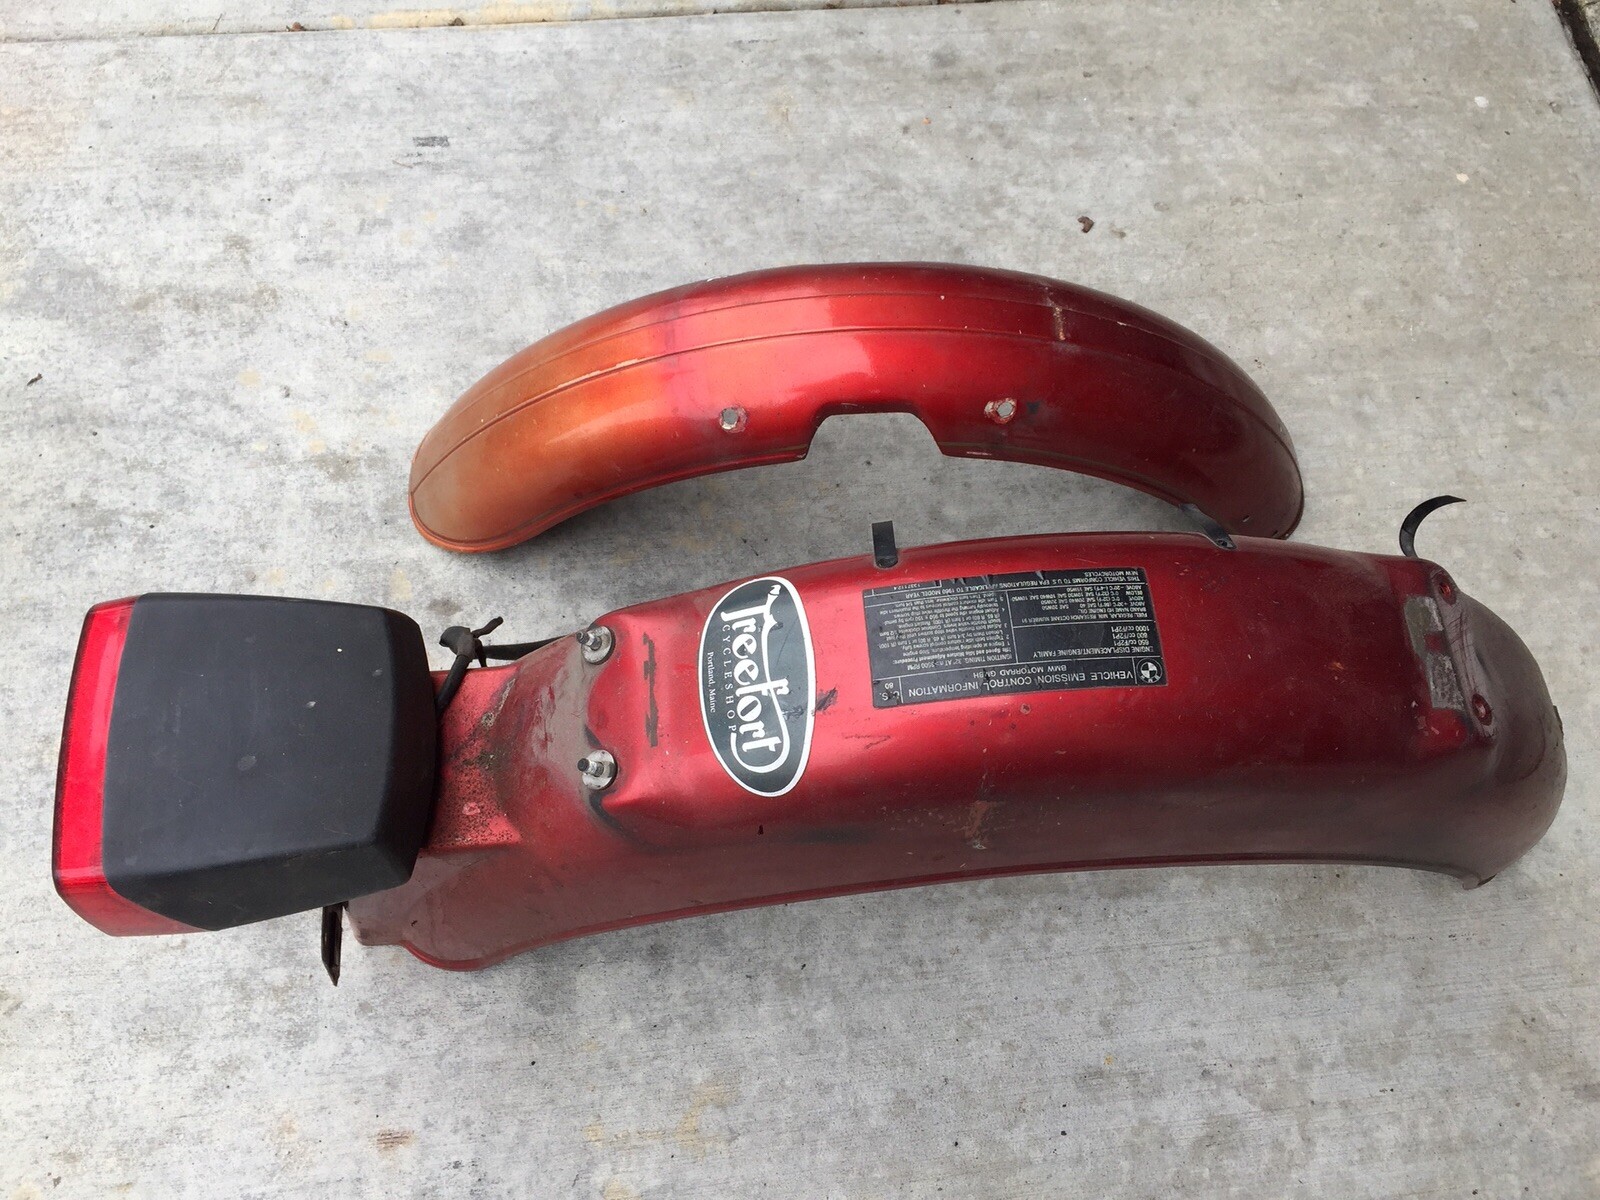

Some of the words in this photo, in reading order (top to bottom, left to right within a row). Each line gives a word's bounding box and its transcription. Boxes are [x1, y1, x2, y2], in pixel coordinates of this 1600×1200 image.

[1032, 649, 1056, 658] FAMILY
[1057, 646, 1130, 656] DISPLACEMENT/ENGINE
[1131, 644, 1153, 653] ENGINE
[707, 651, 717, 687] Portland,
[999, 666, 1043, 675] MOTORRAD
[1036, 672, 1085, 683] EMISSION
[1089, 670, 1132, 680] VEHICLE
[982, 676, 1031, 689] CONTROL
[907, 681, 978, 696] INFORMATION
[708, 688, 717, 713] Maine
